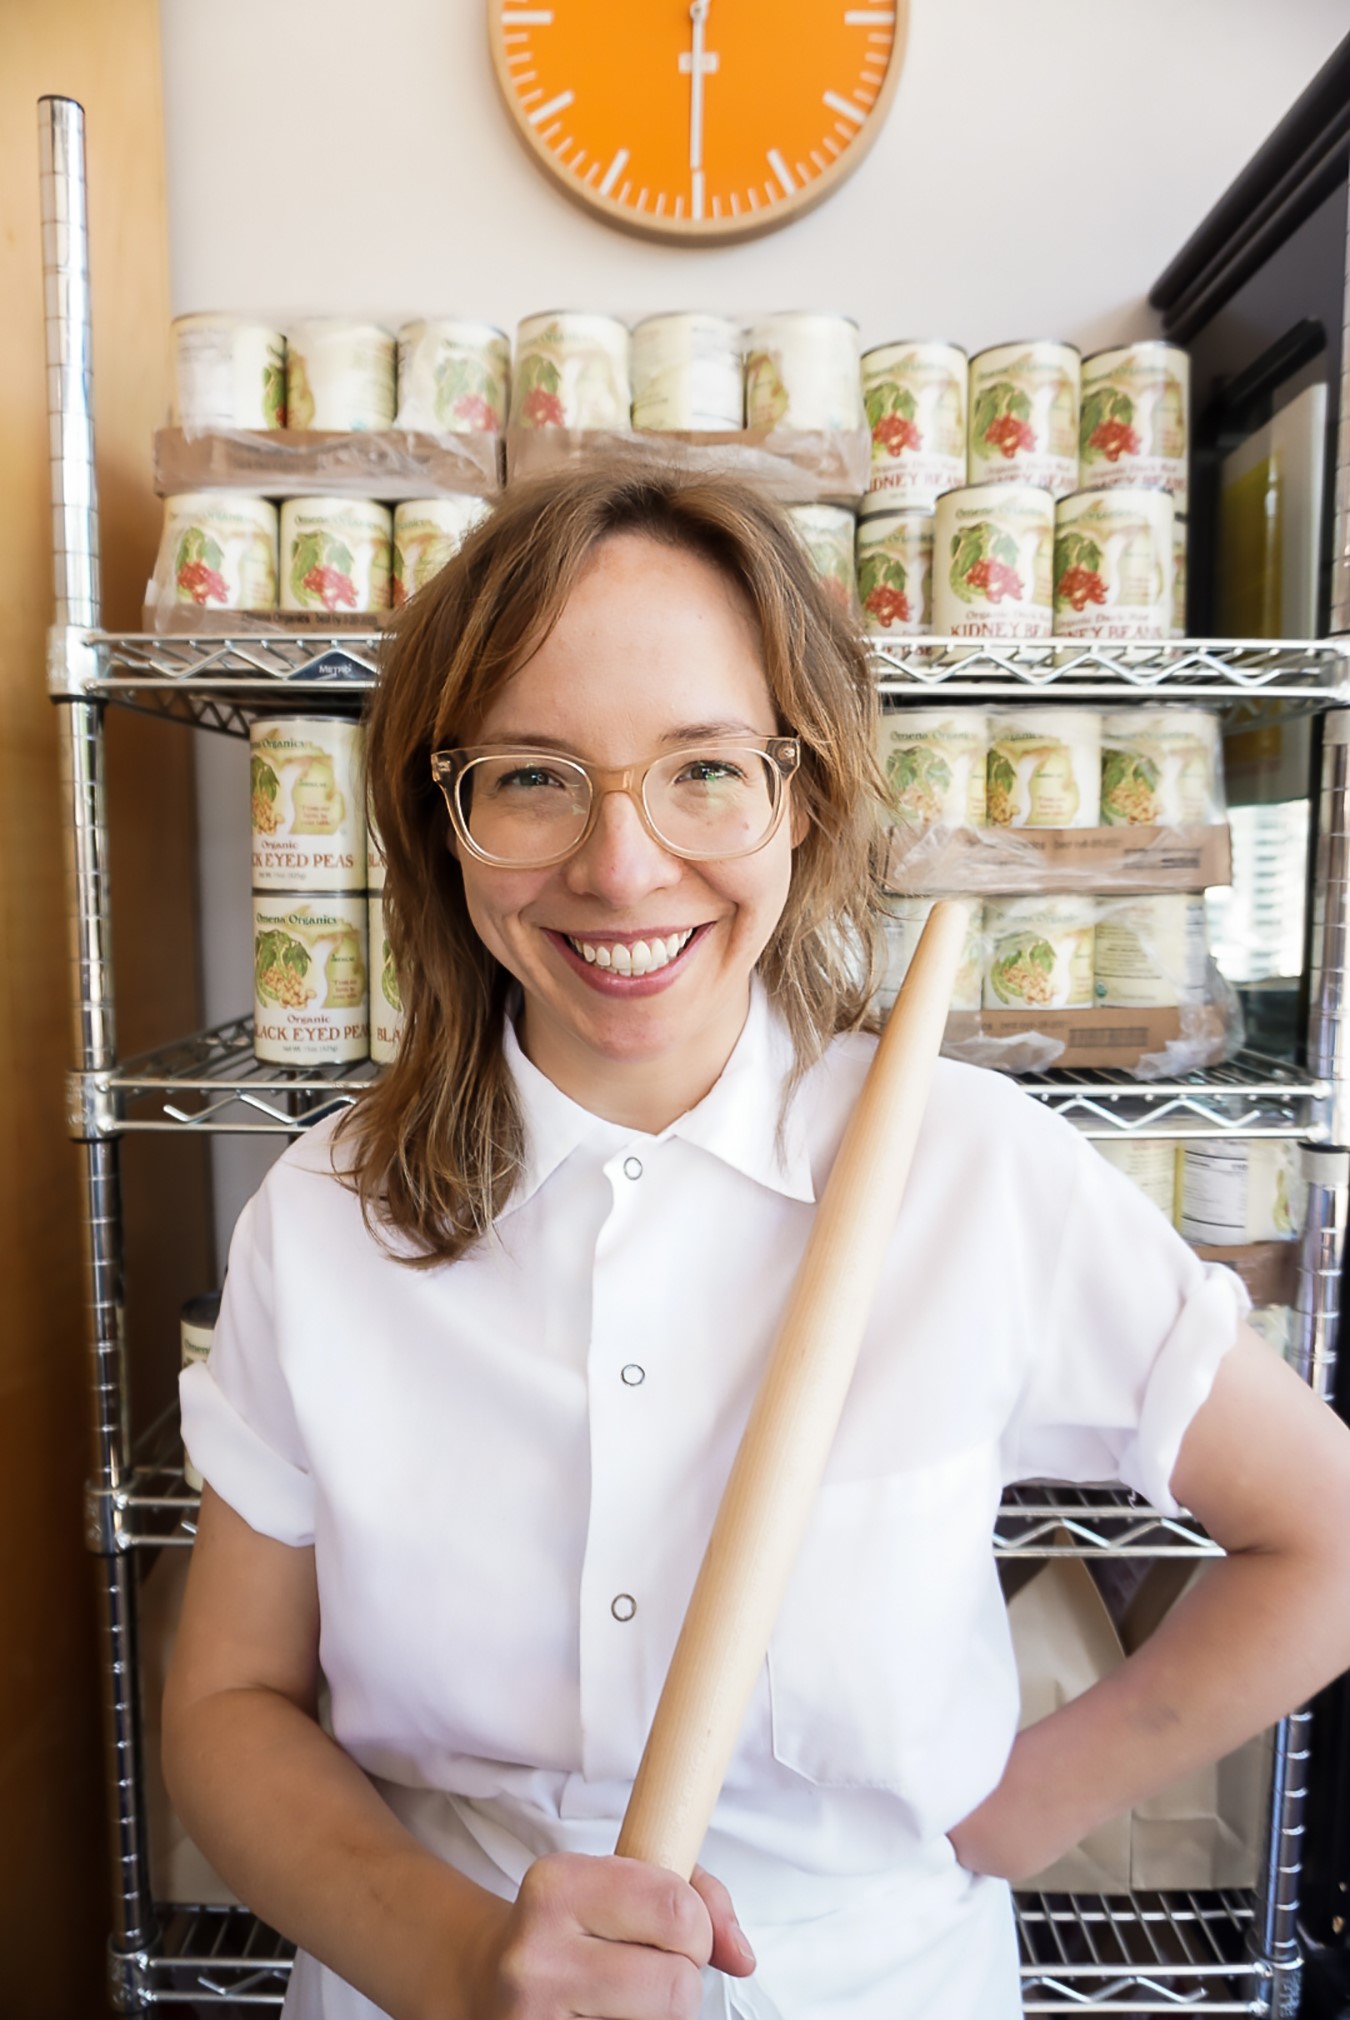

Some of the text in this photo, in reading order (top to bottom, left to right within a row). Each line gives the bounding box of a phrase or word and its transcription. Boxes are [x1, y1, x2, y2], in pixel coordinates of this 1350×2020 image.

[262, 738, 305, 750] Organics
[261, 840, 297, 851] Organic
[313, 853, 354, 869] PEAS
[288, 914, 338, 926] Organics
[287, 1014, 330, 1025] Organic
[293, 1026, 341, 1042] EYED
